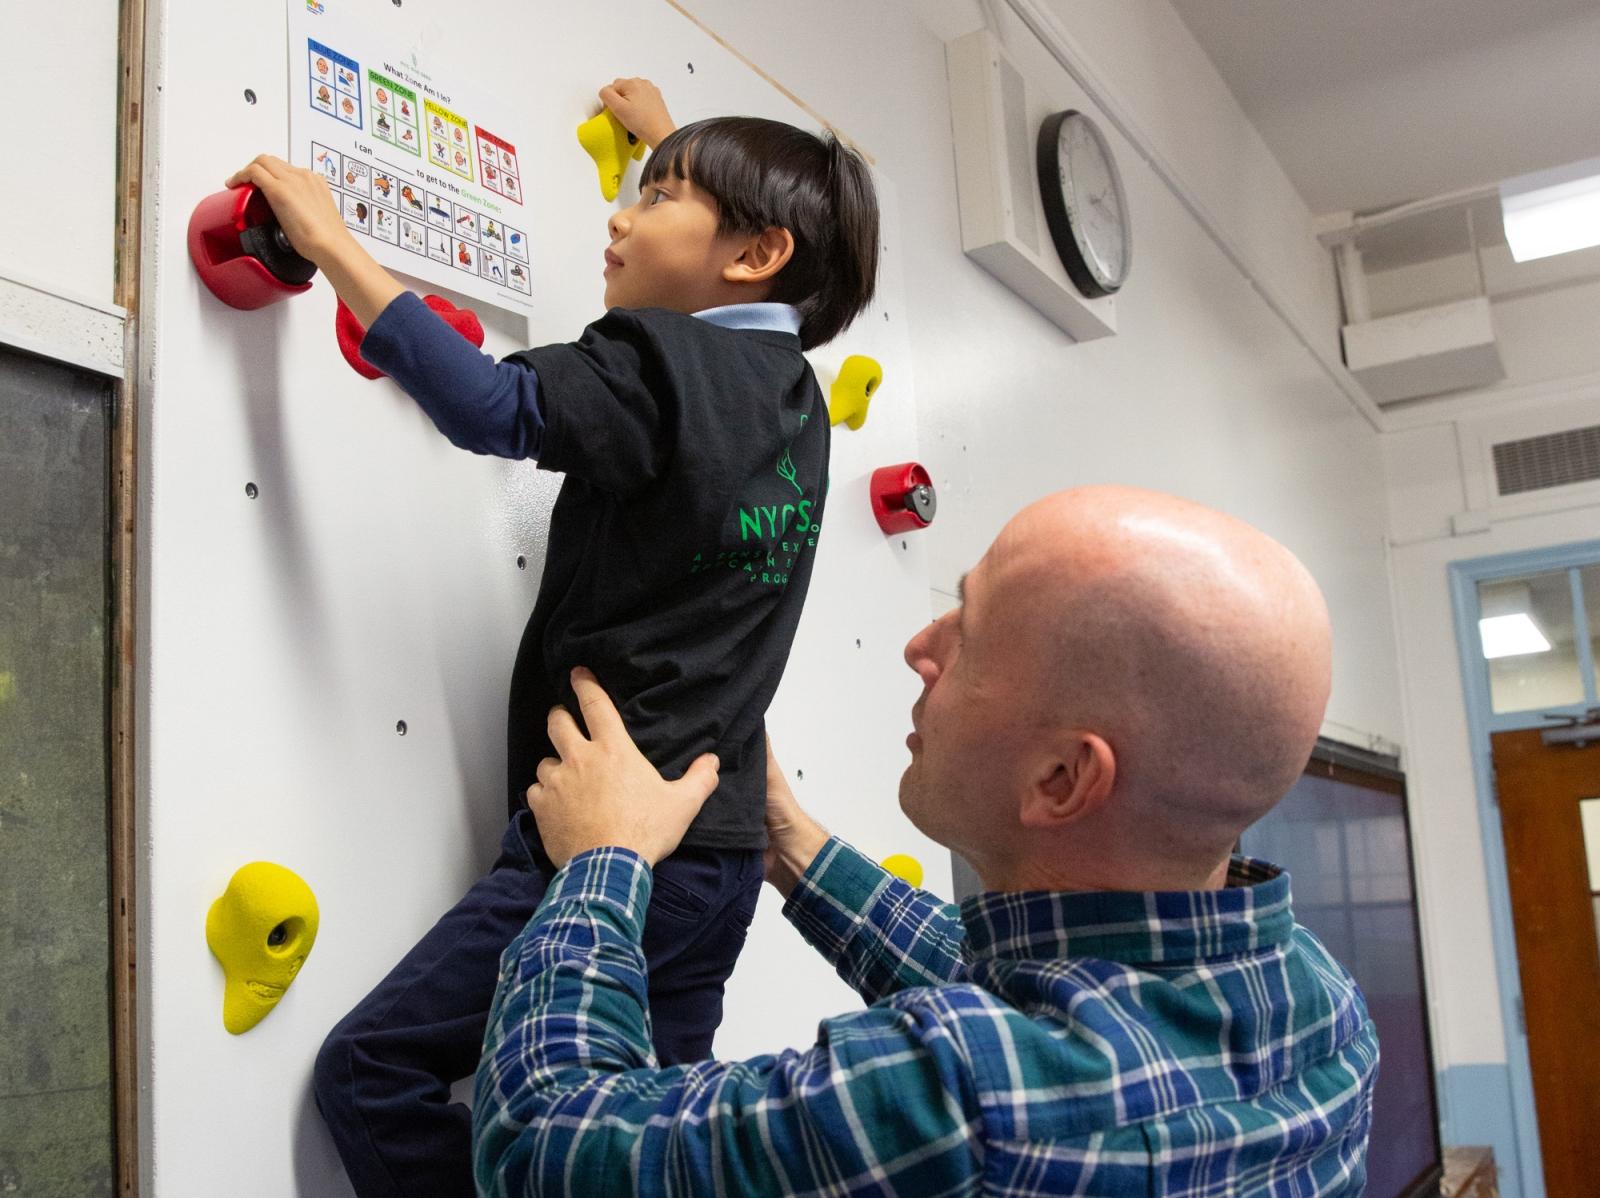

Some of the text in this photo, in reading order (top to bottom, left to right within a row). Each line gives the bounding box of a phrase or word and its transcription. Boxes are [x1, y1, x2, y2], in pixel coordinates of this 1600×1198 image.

[383, 62, 404, 79] What
[404, 73, 423, 89] Zone
[423, 84, 436, 97] Am
[359, 144, 373, 156] can
[416, 169, 425, 178] to
[426, 174, 438, 185] get
[439, 179, 448, 189] to
[448, 183, 460, 194] the
[460, 188, 481, 204] Green
